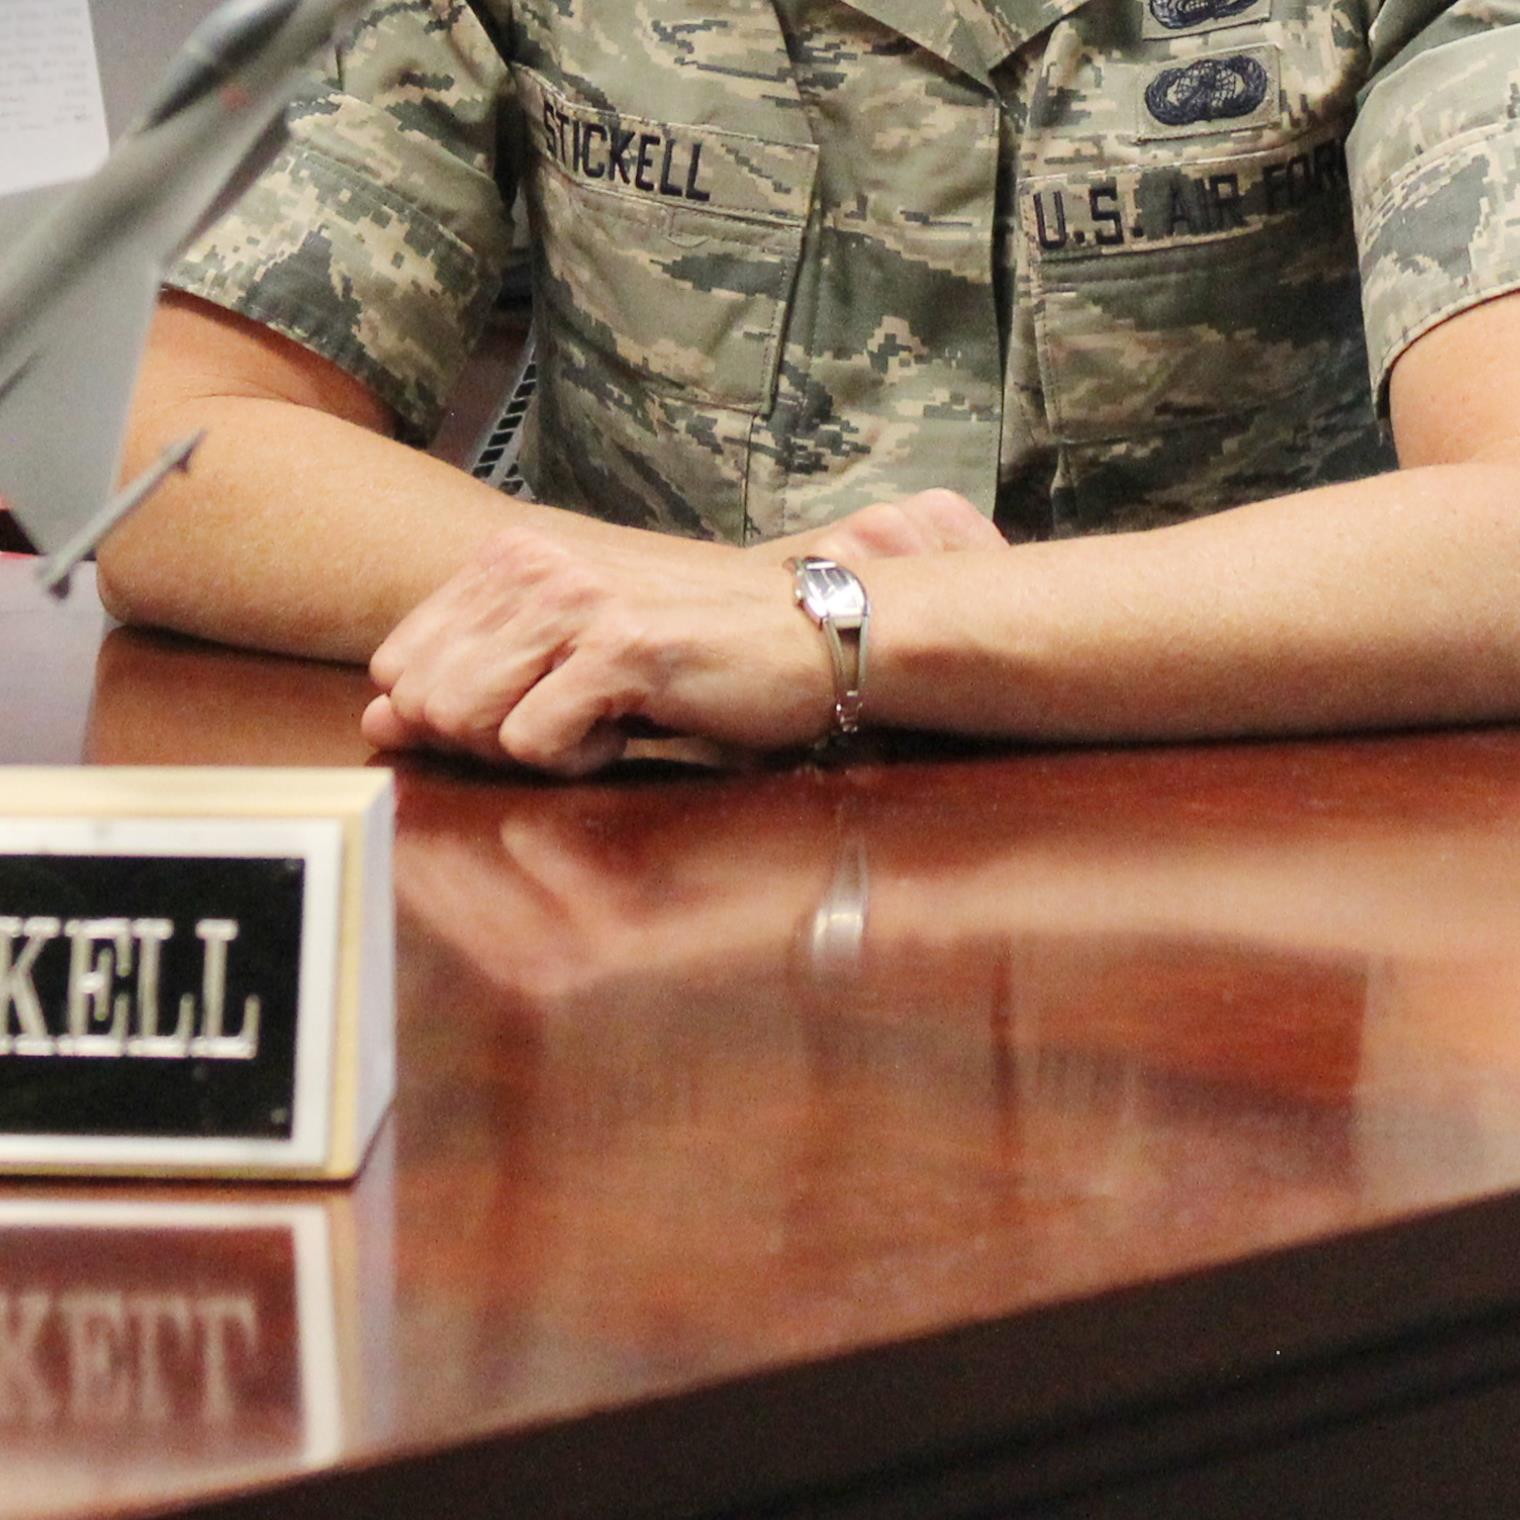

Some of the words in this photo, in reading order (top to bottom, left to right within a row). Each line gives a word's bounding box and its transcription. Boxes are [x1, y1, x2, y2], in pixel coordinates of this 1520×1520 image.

[543, 98, 711, 202] STICKELL
[1032, 177, 1144, 250] U.S.
[1169, 174, 1247, 237] AIR
[1262, 137, 1345, 215] FOR
